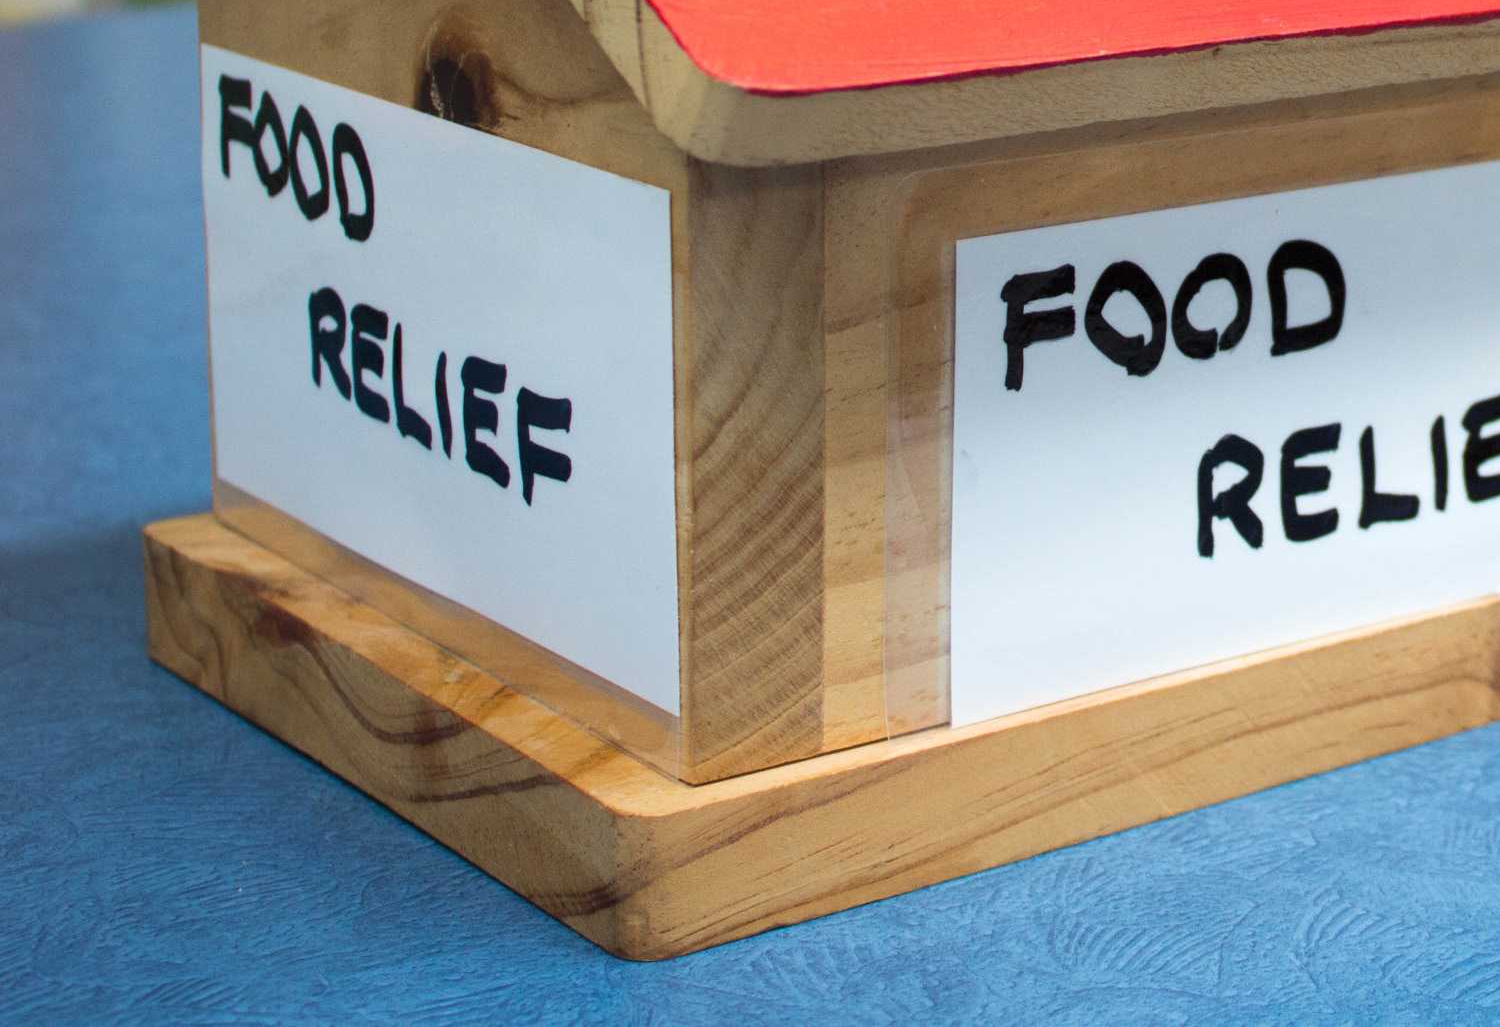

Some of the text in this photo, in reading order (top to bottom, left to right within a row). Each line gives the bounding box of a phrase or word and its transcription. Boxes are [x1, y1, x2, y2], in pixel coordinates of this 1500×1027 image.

[218, 73, 374, 242] FOOD
[308, 287, 572, 507] RELIEF
[1000, 239, 1346, 391] FOOD
